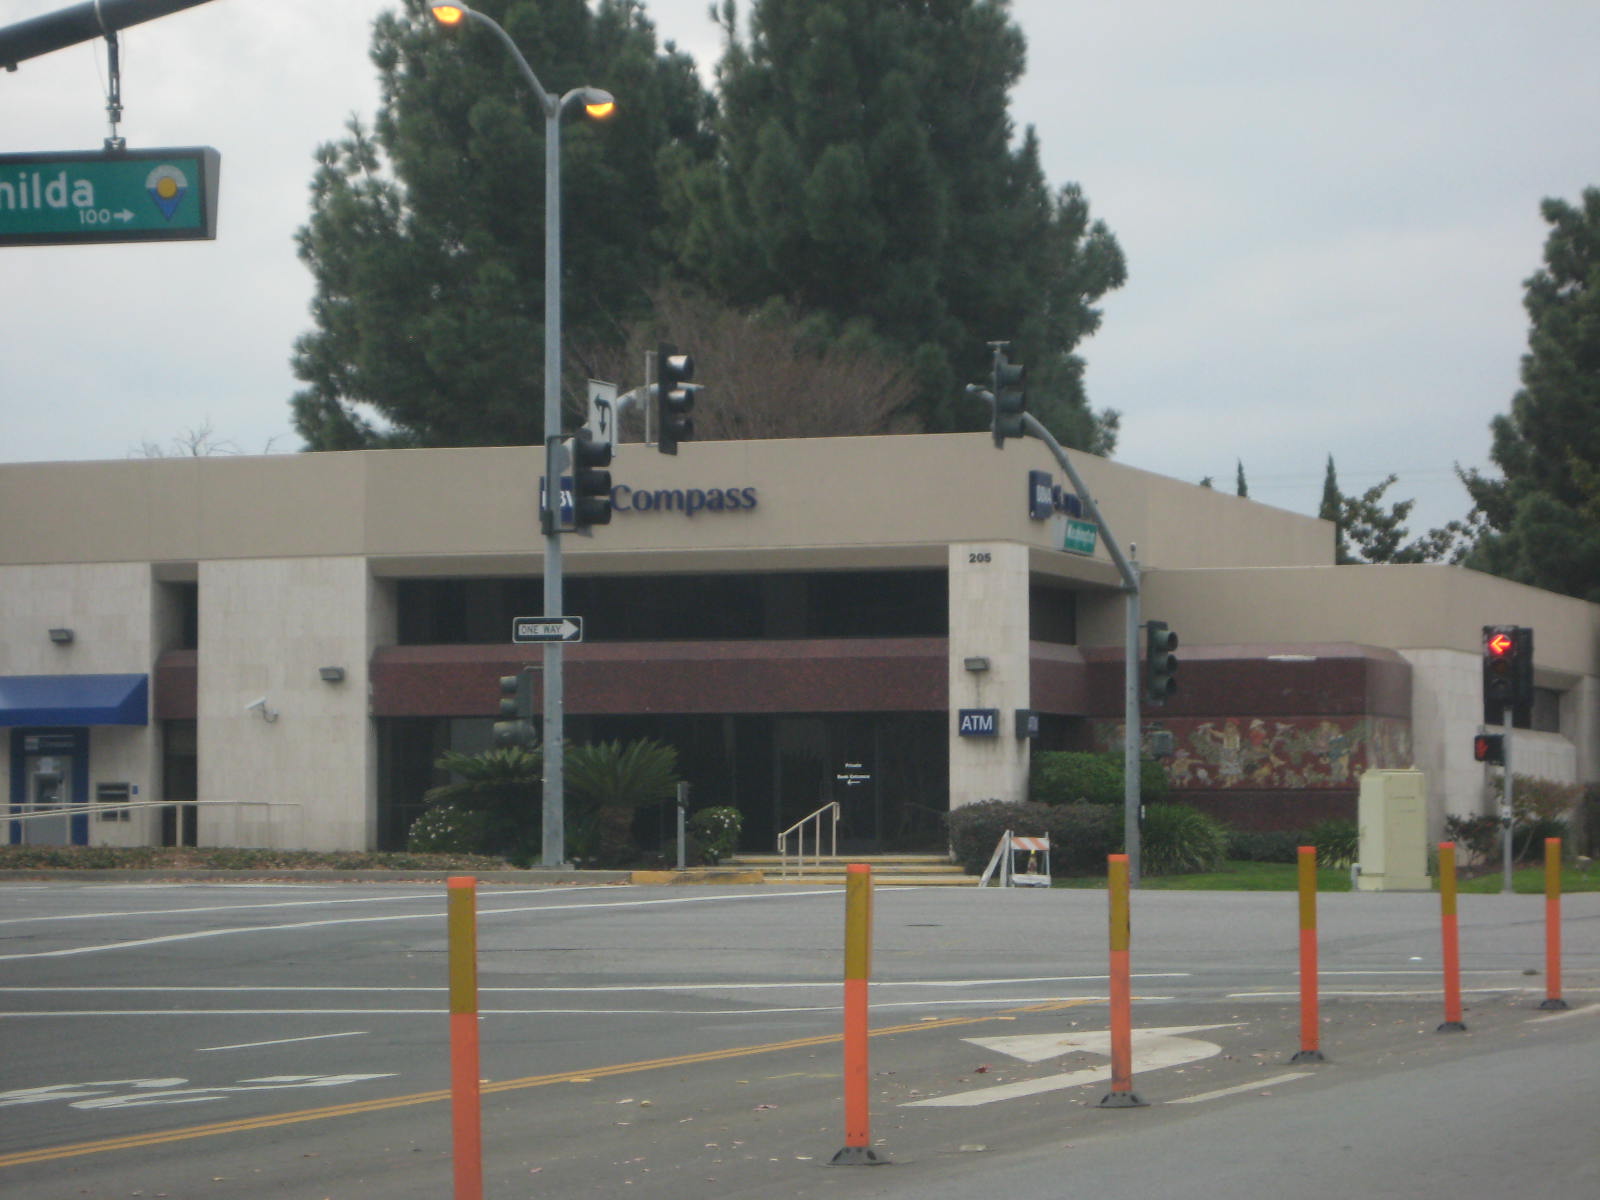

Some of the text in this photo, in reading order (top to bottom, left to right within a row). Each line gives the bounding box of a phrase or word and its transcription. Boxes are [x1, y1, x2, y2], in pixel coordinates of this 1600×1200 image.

[79, 209, 110, 224] 100
[610, 484, 758, 517] Compass
[969, 552, 992, 563] 205
[521, 625, 561, 634] ONE WAY
[961, 715, 993, 731] ATM
